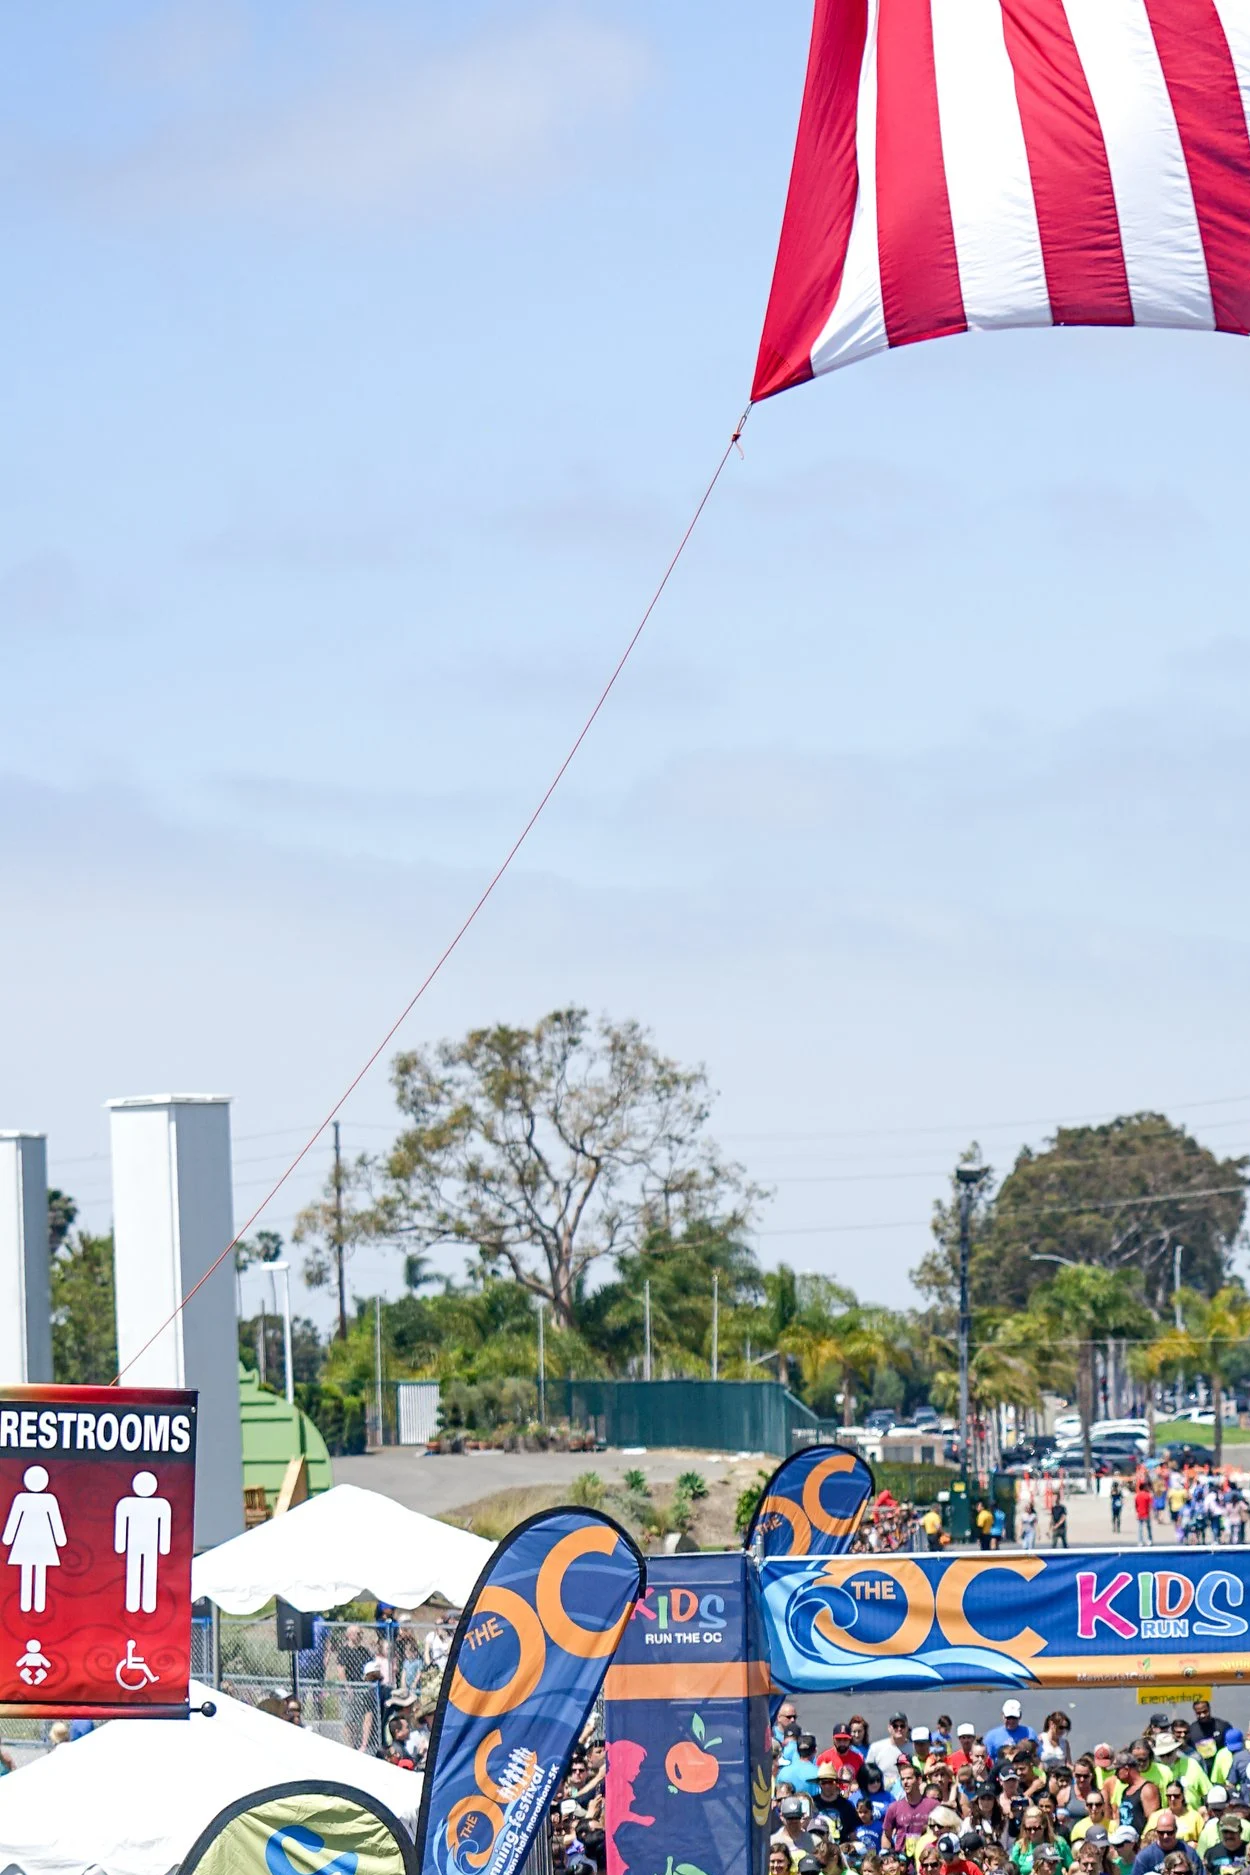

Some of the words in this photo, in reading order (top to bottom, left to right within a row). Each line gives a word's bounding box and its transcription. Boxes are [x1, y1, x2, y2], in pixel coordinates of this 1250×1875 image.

[0, 1411, 191, 1453] RESTROOMS
[631, 1587, 728, 1629] KIDS
[814, 1556, 1048, 1658] OC
[850, 1580, 896, 1601] THE
[1076, 1570, 1248, 1640] KIDS
[449, 1525, 635, 1717] OC
[464, 1617, 504, 1653] THE
[645, 1633, 672, 1645] RUN
[675, 1632, 700, 1644] THE
[703, 1632, 722, 1643] OC
[1142, 1619, 1189, 1638] RUN
[509, 1764, 546, 1829] festival
[460, 1814, 478, 1839] THE
